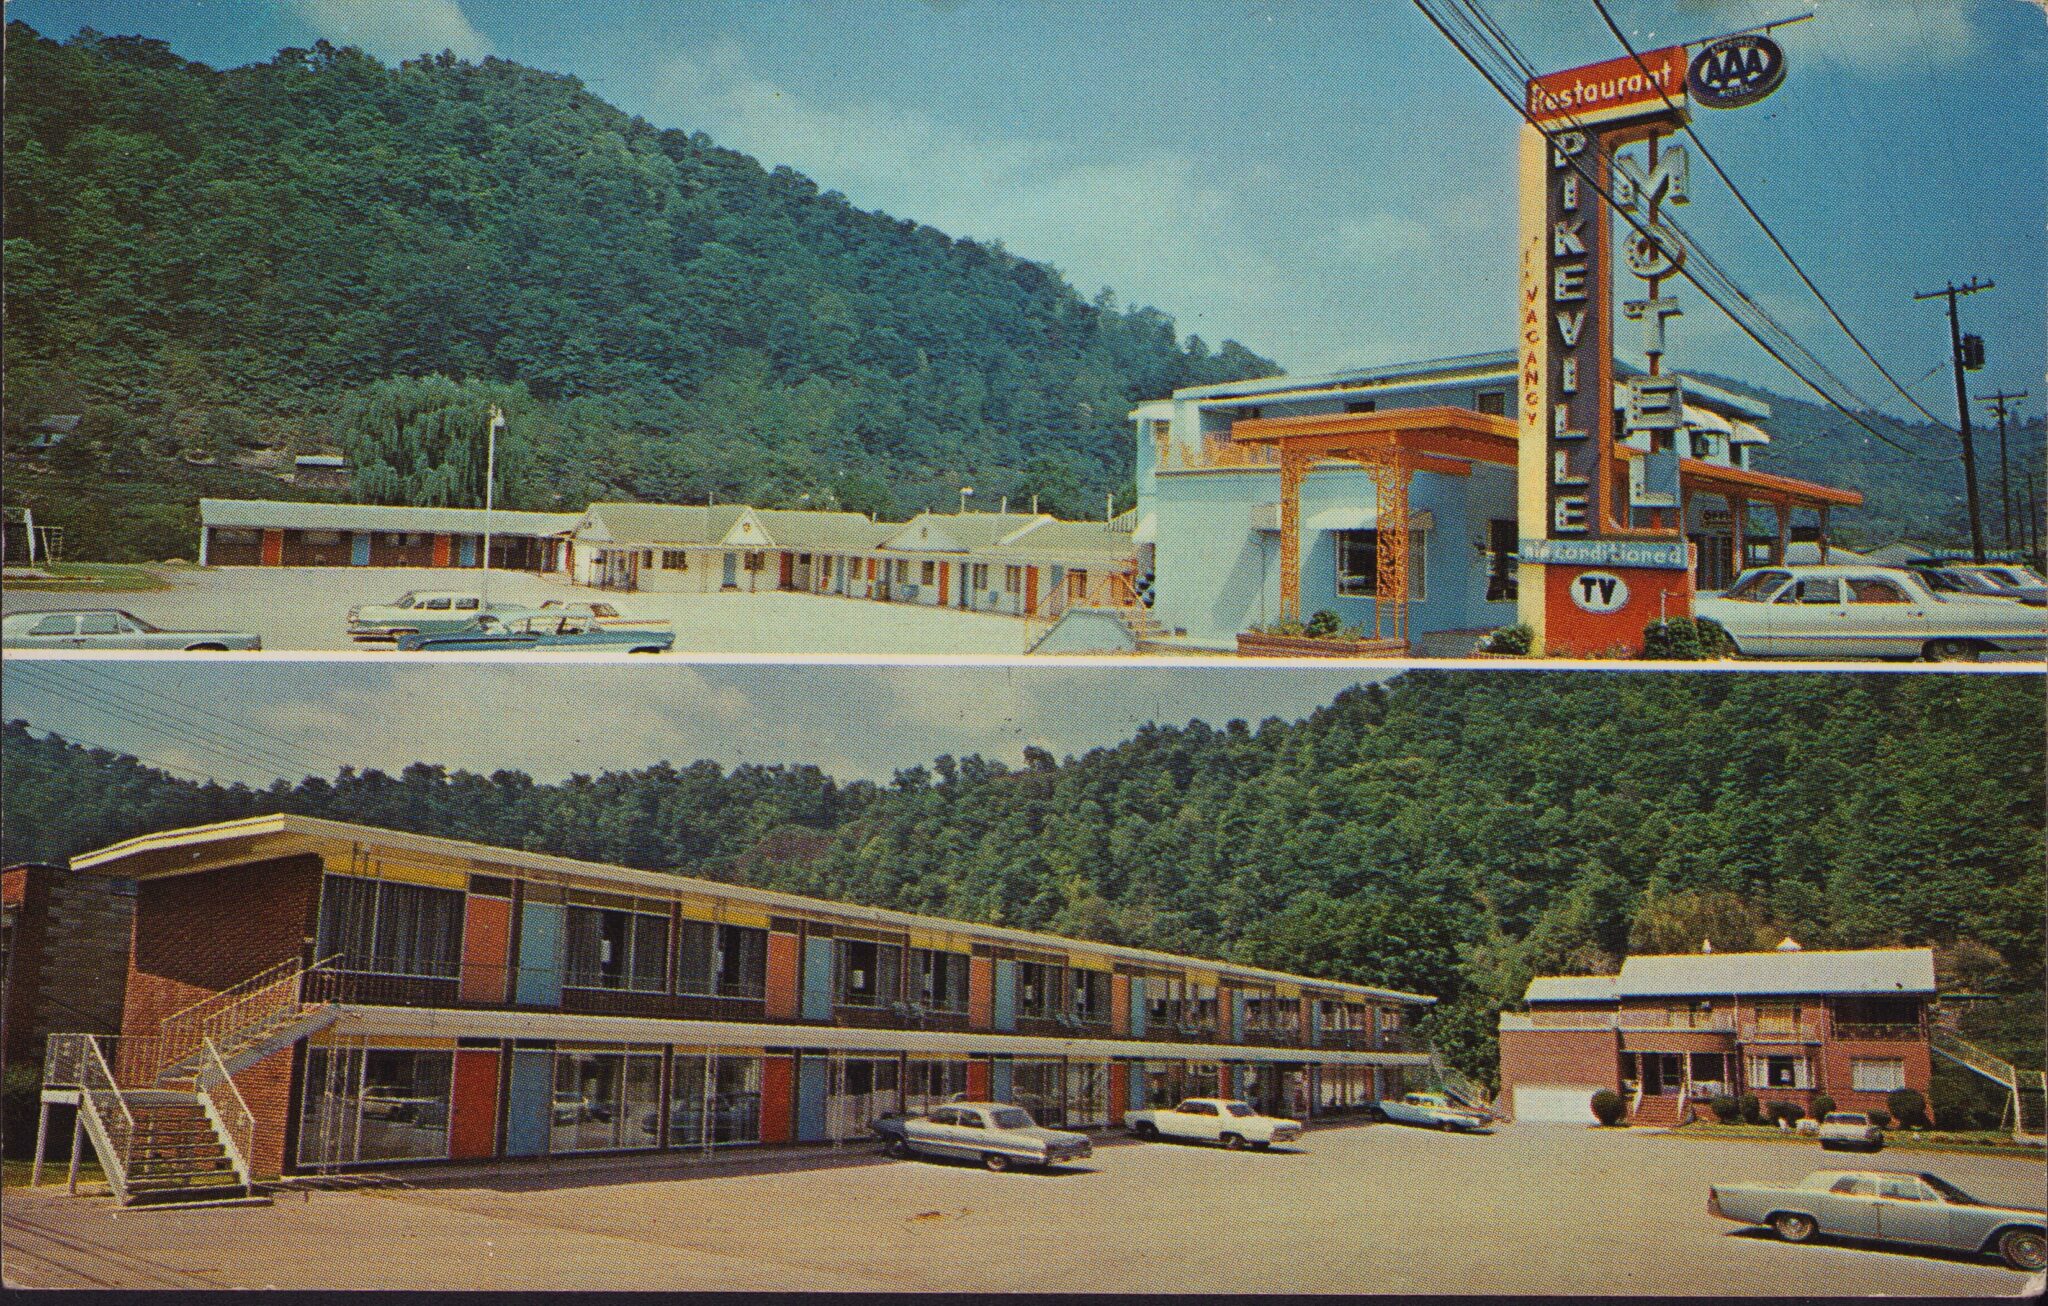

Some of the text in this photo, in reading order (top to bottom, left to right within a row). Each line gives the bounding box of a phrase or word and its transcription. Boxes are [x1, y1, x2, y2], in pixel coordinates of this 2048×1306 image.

[1530, 60, 1672, 115] Restaurant
[1705, 46, 1764, 88] AAA
[1554, 132, 1590, 533] PIKEVILLE
[1613, 145, 1691, 508] MOTEL
[1524, 284, 1540, 426] VACANCY
[1554, 543, 1682, 564] conditioned
[1579, 576, 1616, 605] TV
